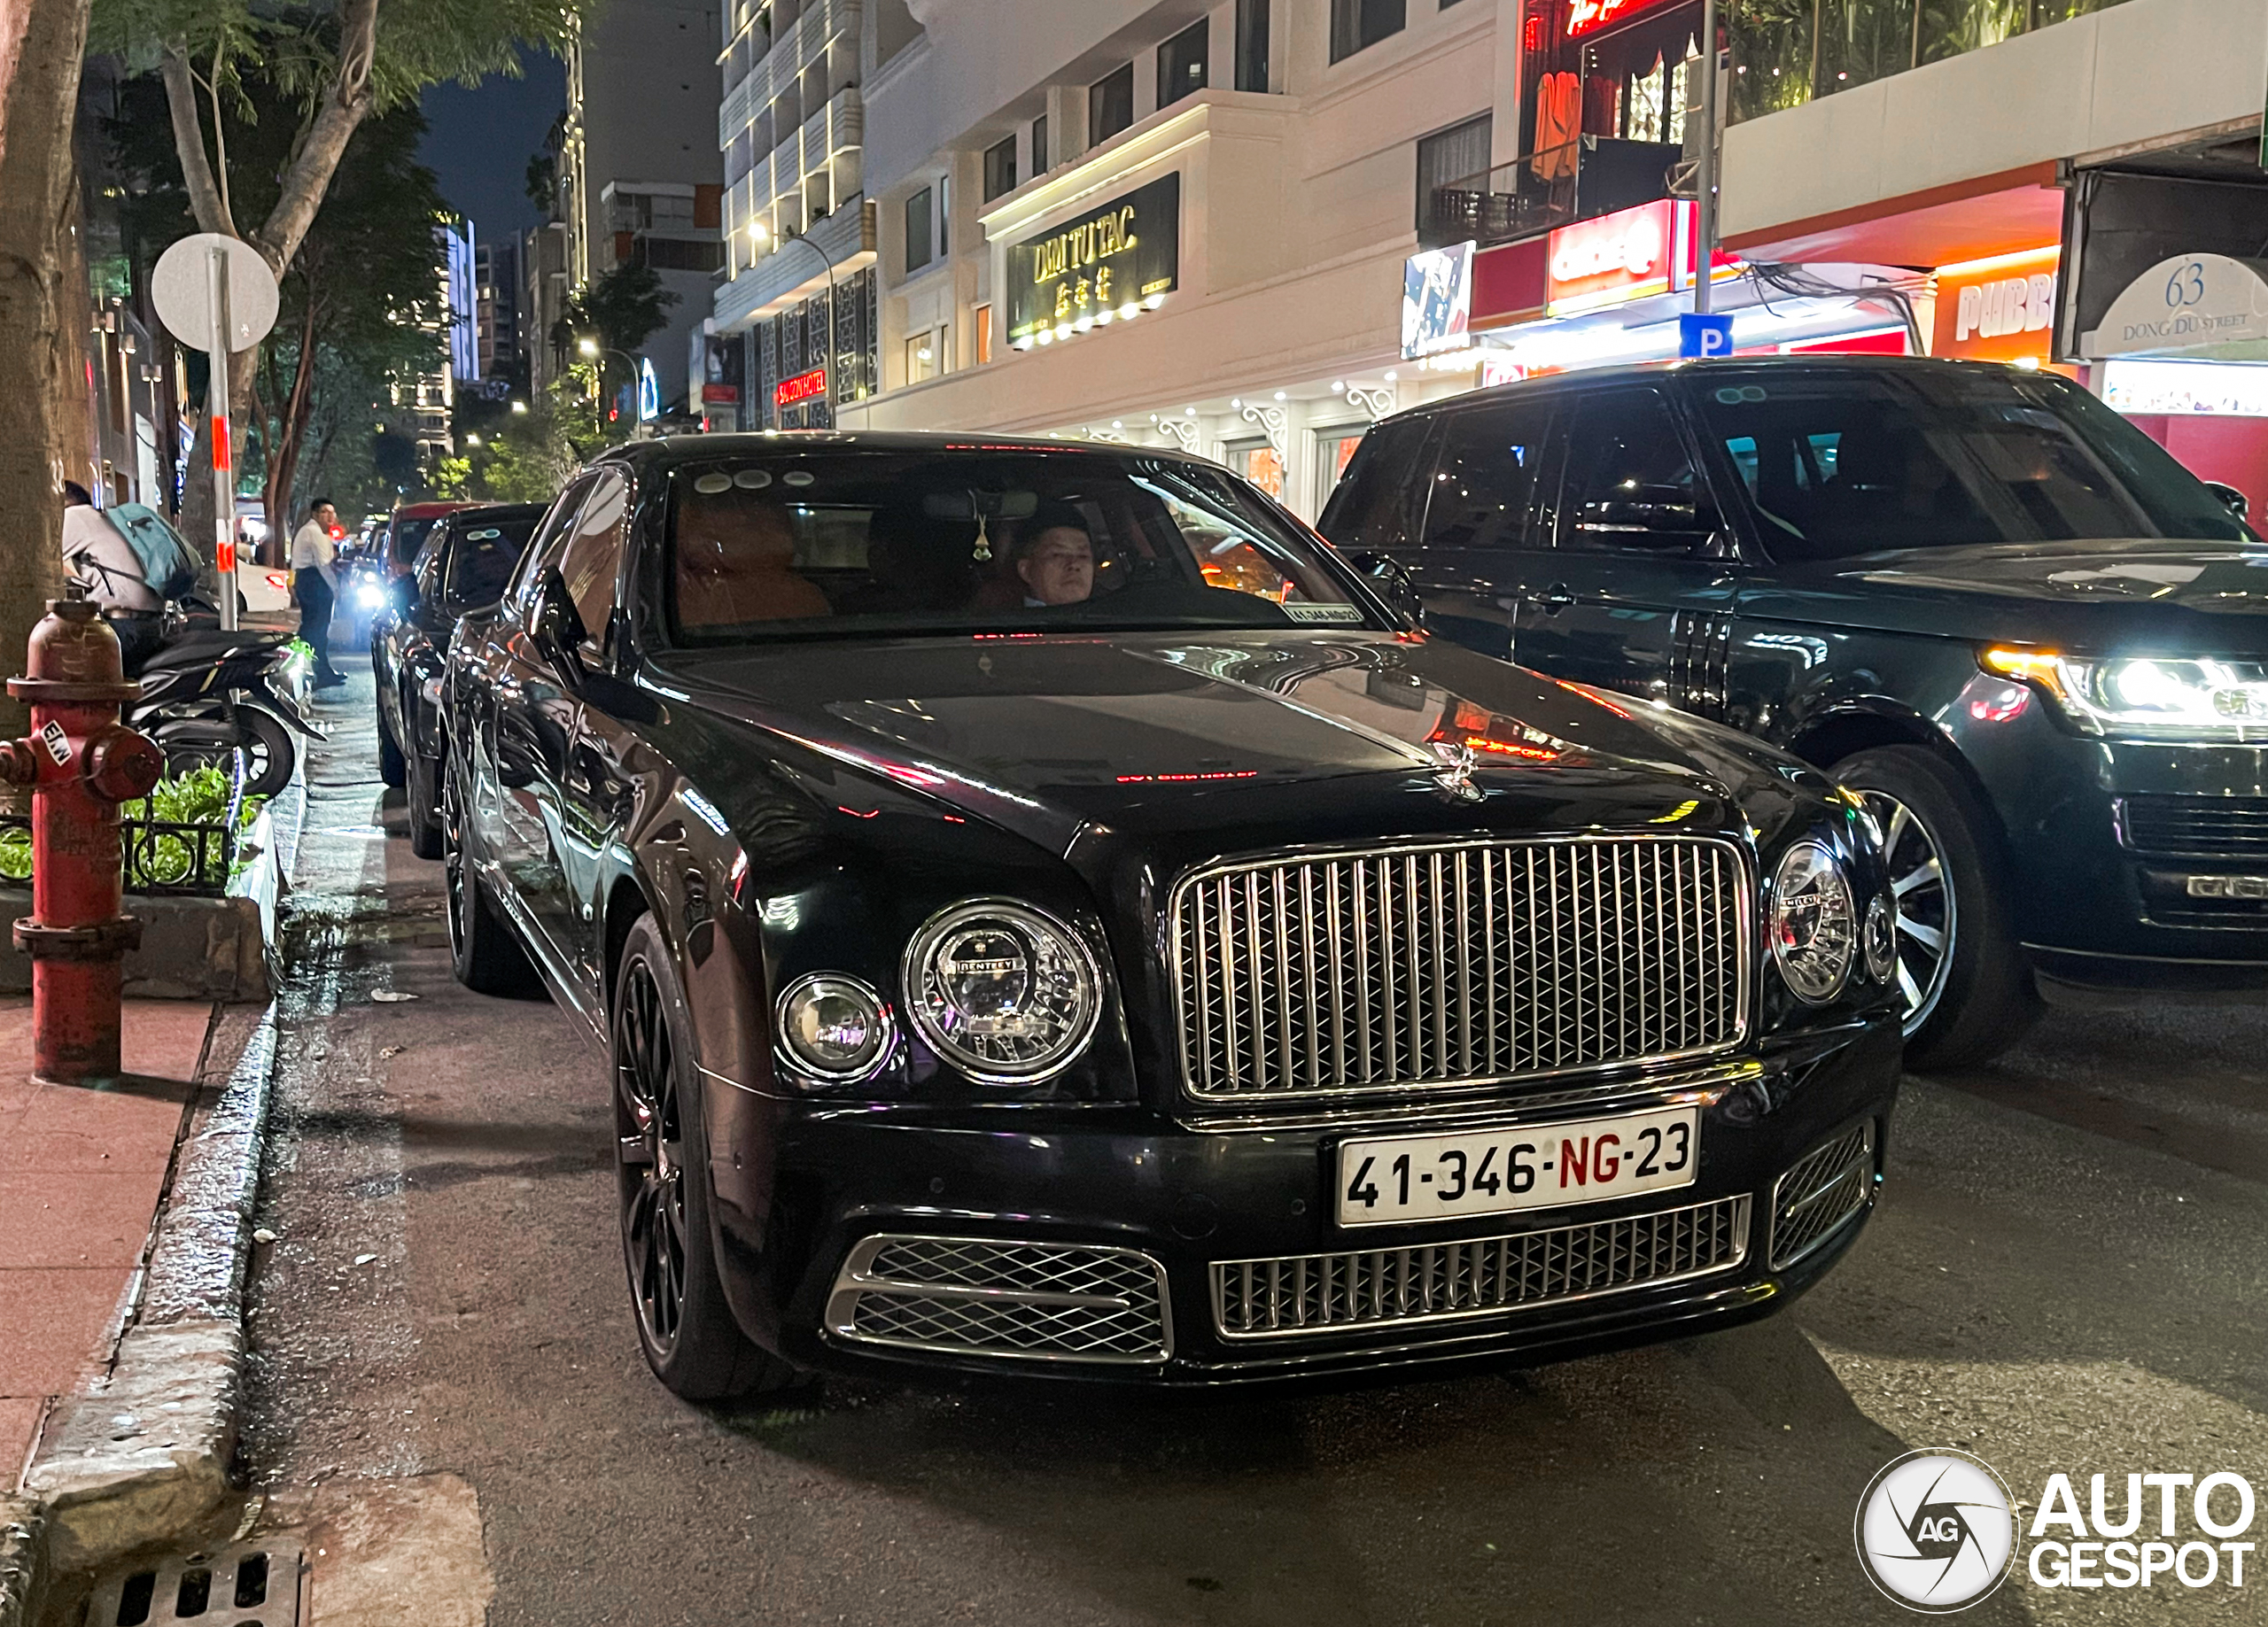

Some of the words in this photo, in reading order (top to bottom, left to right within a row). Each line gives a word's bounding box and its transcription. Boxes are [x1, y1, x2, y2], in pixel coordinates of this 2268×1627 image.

[2165, 262, 2204, 307] 63
[2124, 321, 2171, 341] DONG
[2175, 316, 2199, 335] DU
[2201, 314, 2249, 329] STREET
[1701, 329, 1723, 358] P
[804, 370, 826, 396] HOTEL
[960, 960, 1012, 972] BENTLEY
[1347, 1121, 1690, 1208] 41-346-NG-23
